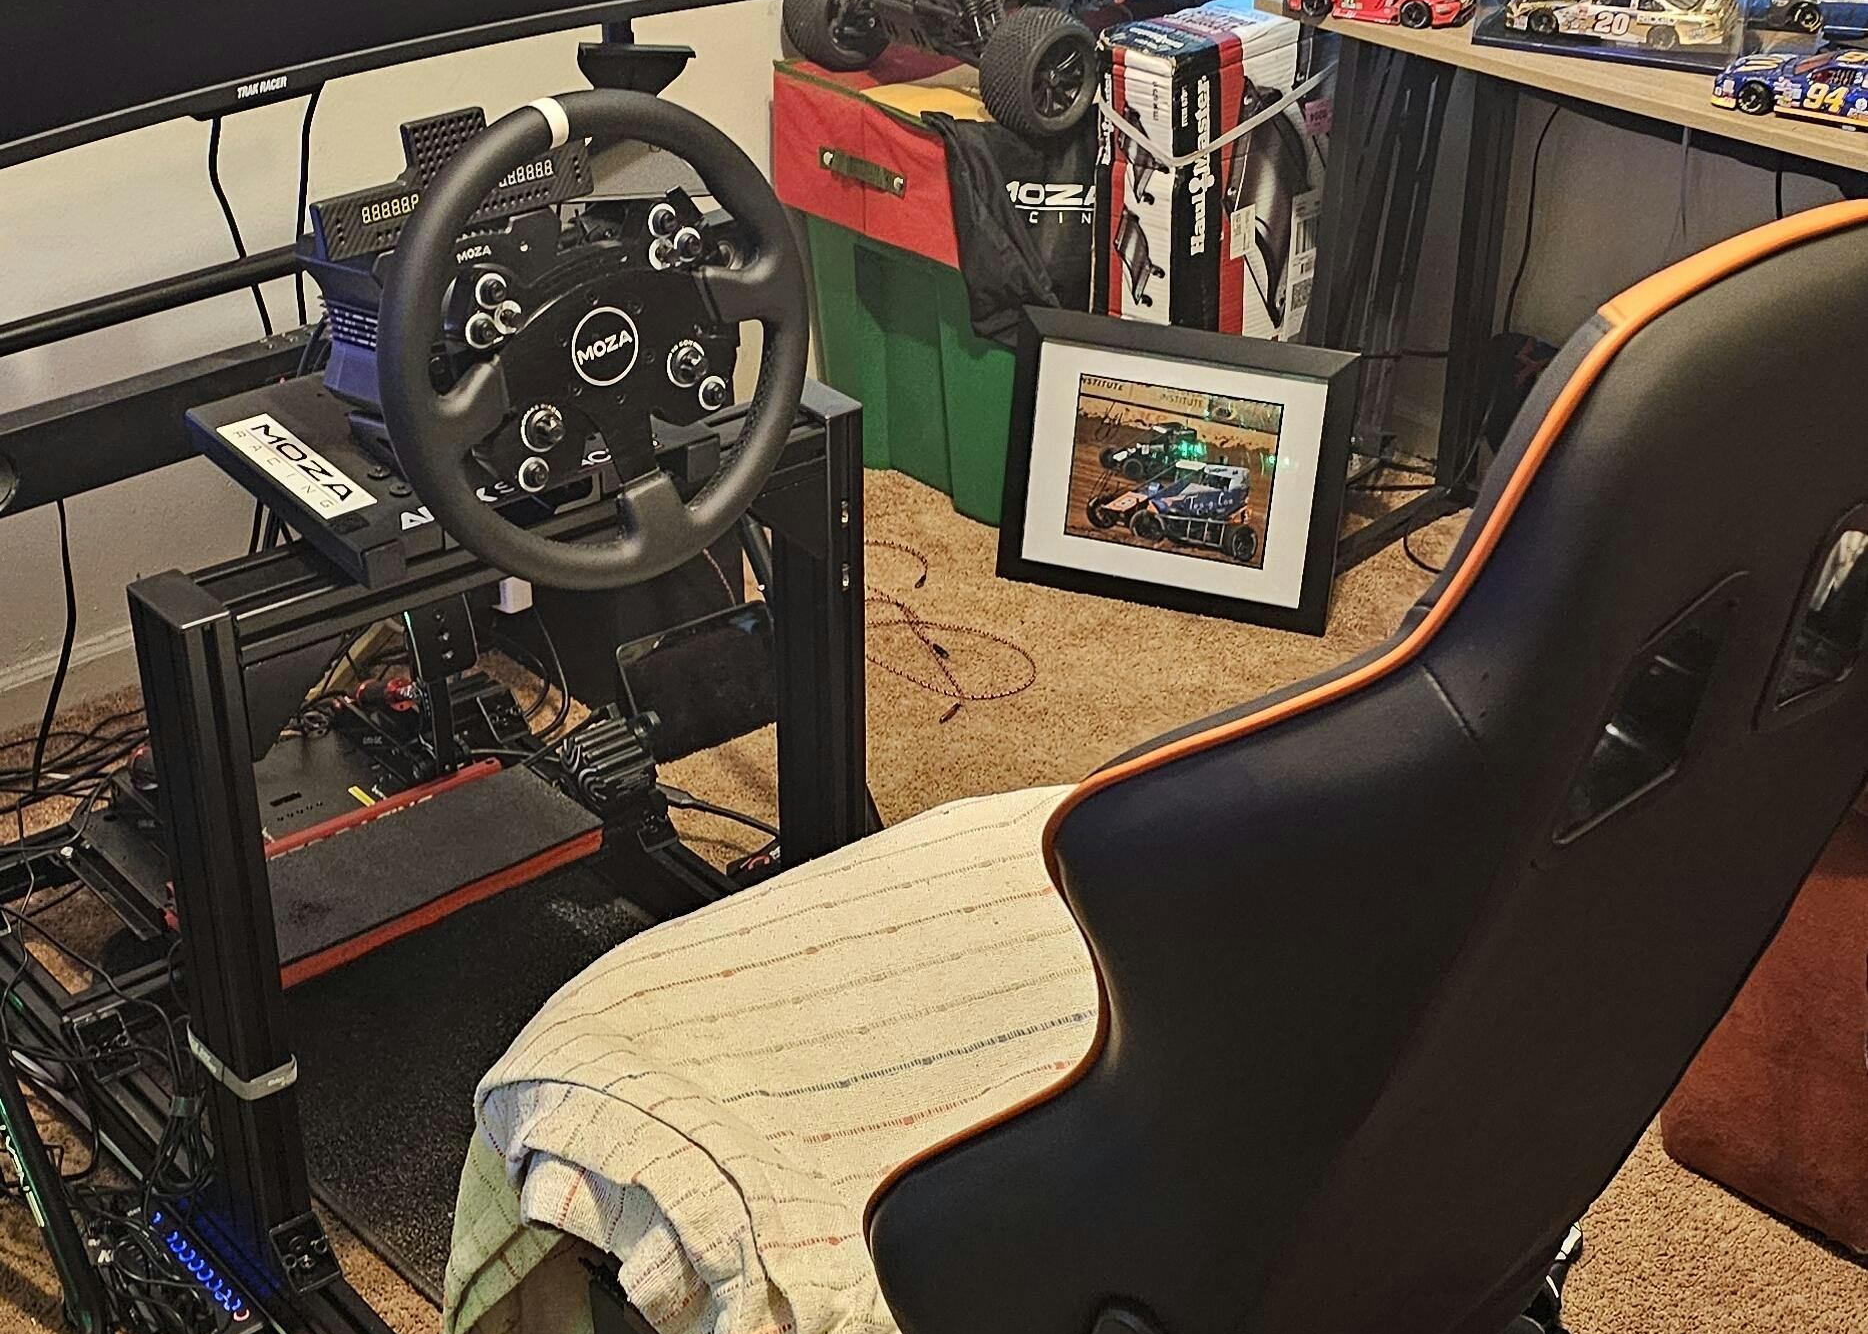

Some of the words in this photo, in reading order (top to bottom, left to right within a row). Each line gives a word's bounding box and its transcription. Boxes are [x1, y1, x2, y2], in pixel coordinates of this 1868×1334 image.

[1593, 11, 1631, 36] 20
[237, 82, 260, 99] TRAK
[1803, 82, 1850, 115] 94
[456, 244, 492, 264] MOZA
[576, 329, 634, 365] MOZA
[232, 430, 334, 509] RACING
[251, 423, 354, 502] MOZA
